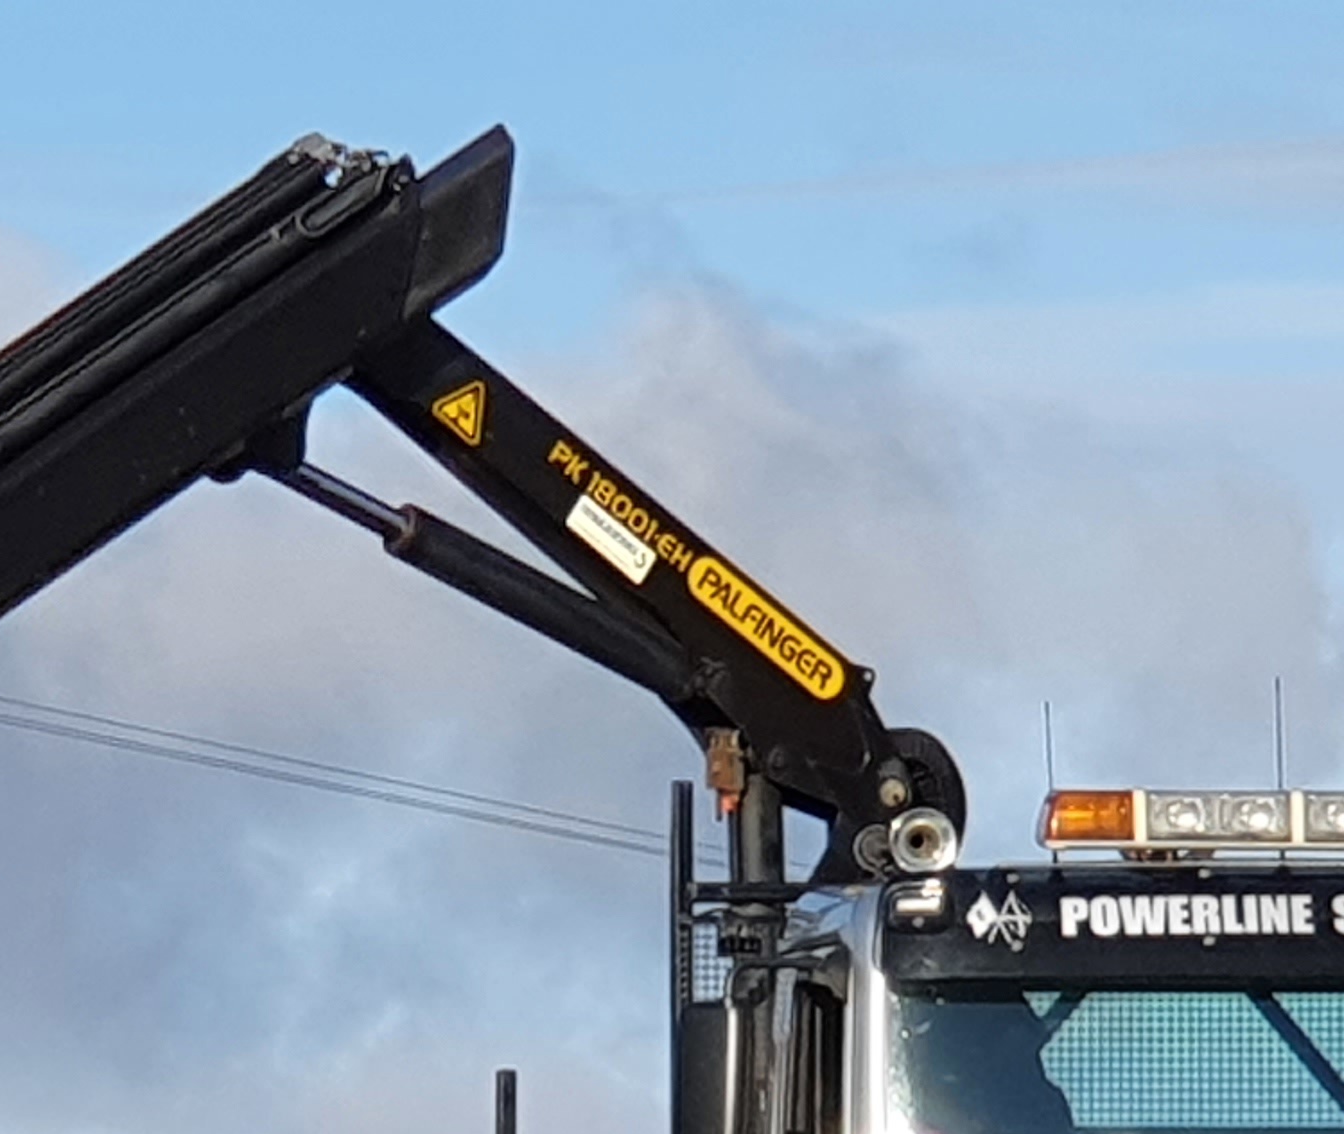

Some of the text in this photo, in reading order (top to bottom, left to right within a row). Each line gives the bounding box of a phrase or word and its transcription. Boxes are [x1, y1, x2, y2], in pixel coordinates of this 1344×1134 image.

[547, 439, 590, 485] PK
[697, 566, 833, 690] PALFINGER
[1059, 894, 1316, 937] POWERLINE
